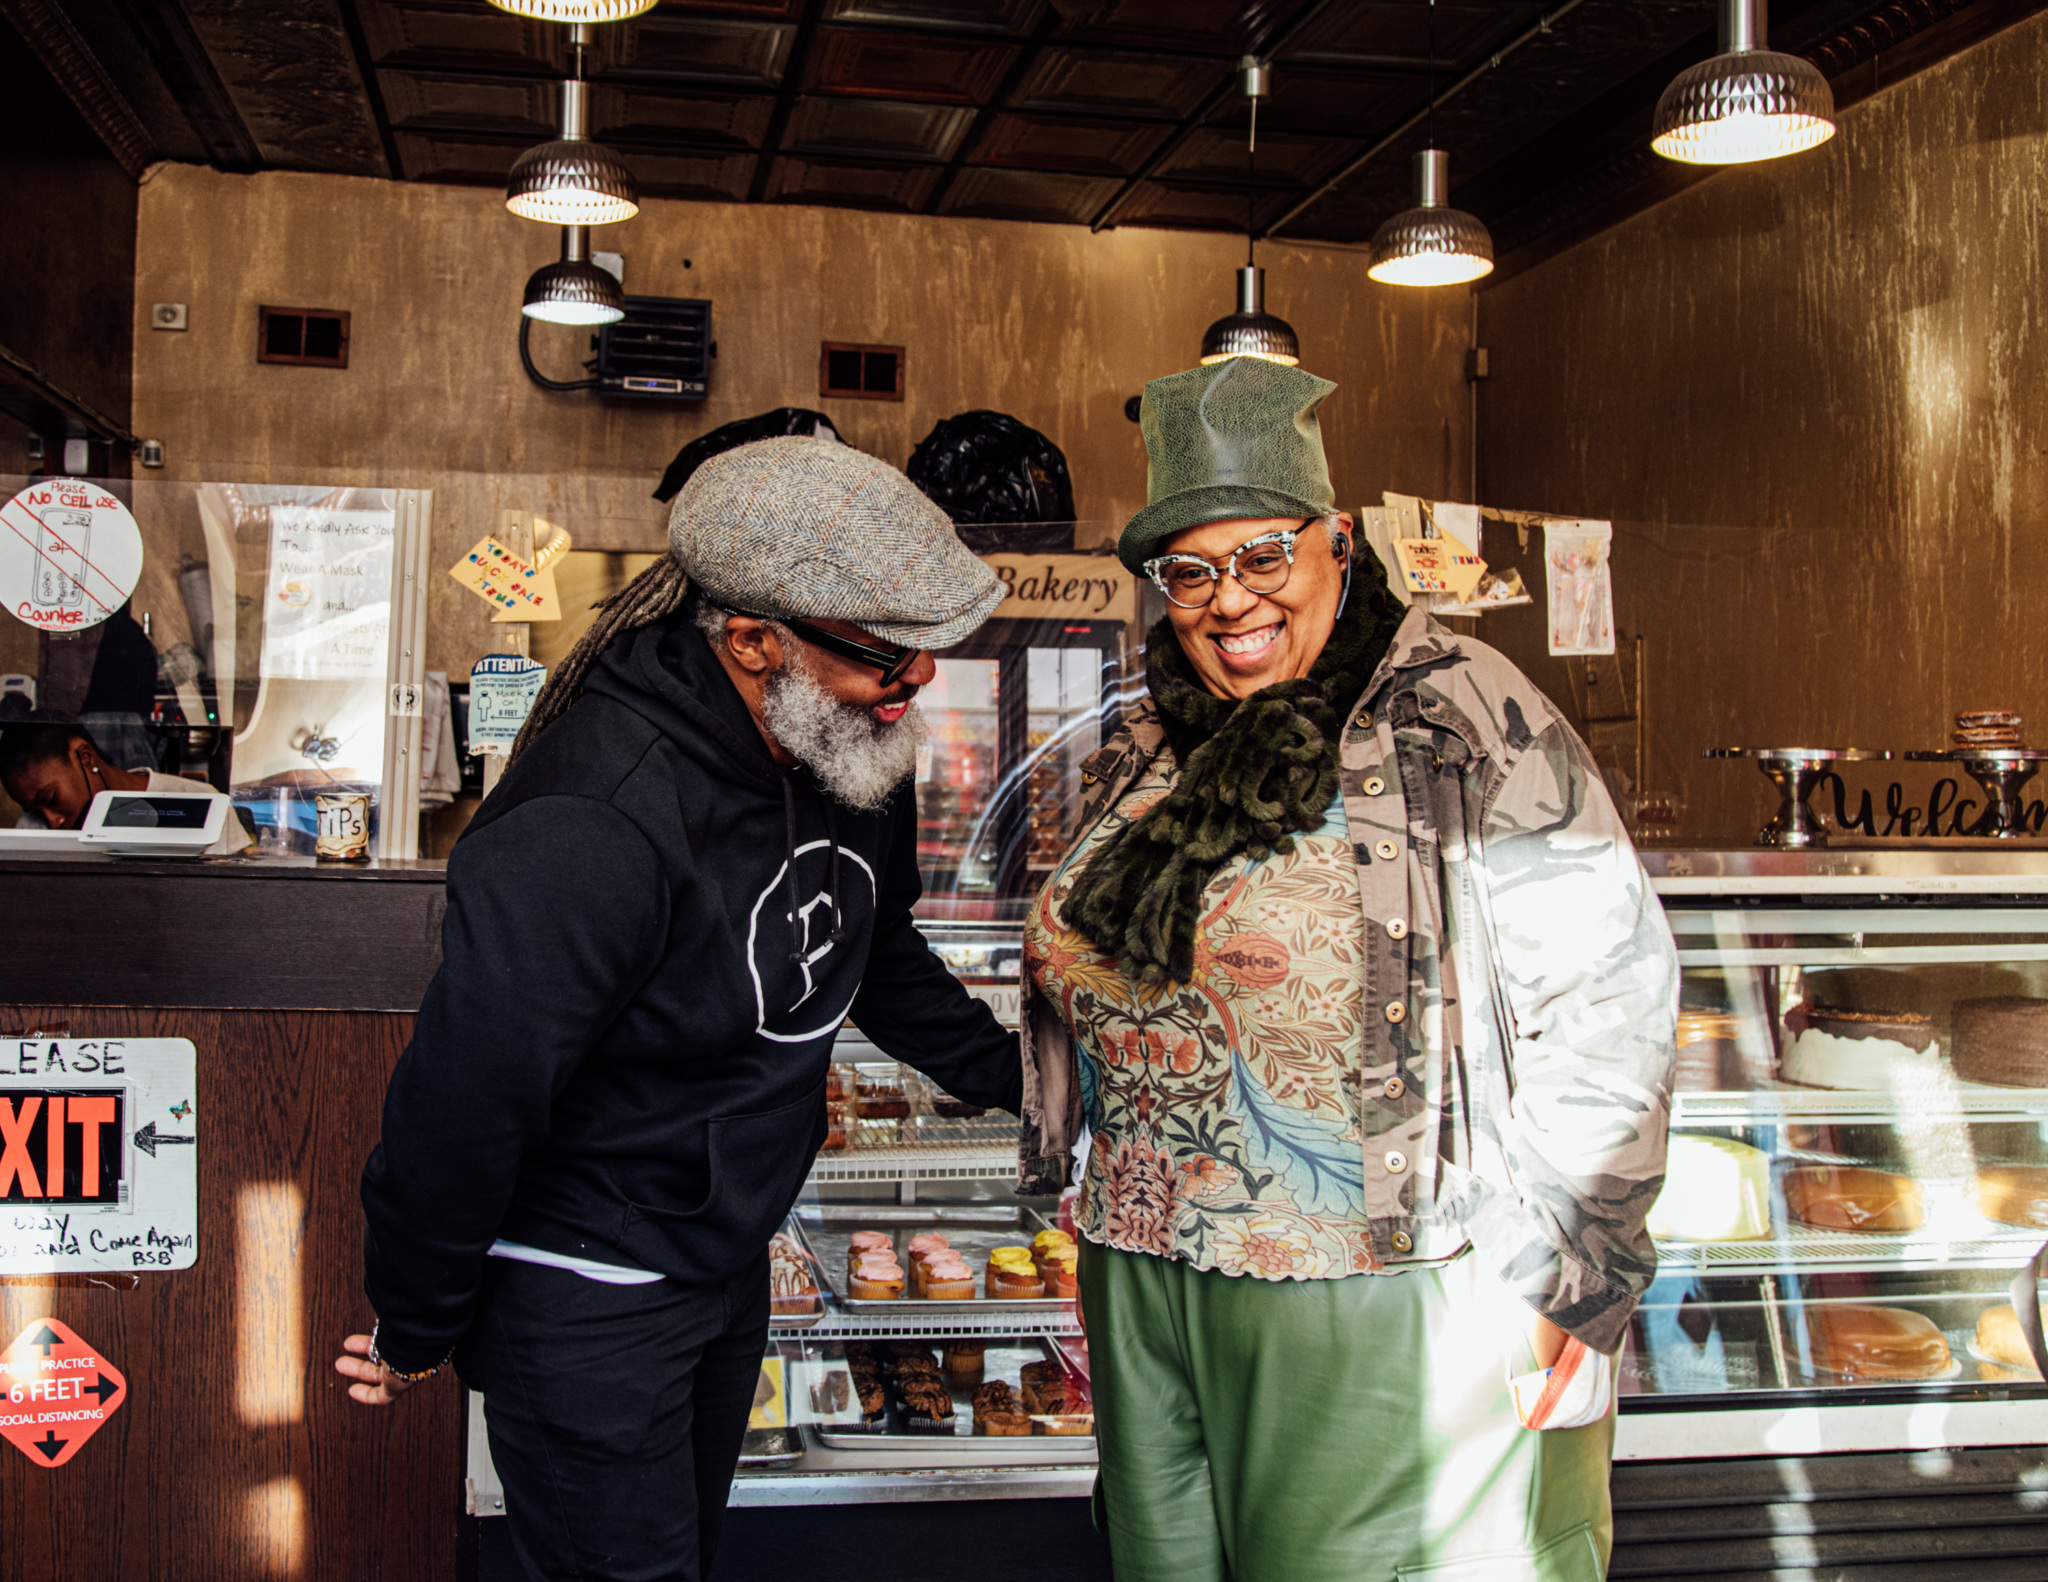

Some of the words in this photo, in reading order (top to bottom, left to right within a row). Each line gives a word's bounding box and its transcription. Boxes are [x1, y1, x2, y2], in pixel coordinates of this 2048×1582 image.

[51, 481, 86, 494] Please
[28, 491, 52, 505] NO
[60, 493, 93, 509] CELL
[345, 523, 369, 536] Ask
[280, 562, 313, 574] Wear
[330, 565, 364, 577] Mask
[510, 583, 544, 606] SALE
[996, 565, 1118, 613] Bakery
[343, 643, 374, 656] Time
[90, 1228, 143, 1253] Come
[147, 1226, 193, 1255] Again
[132, 1251, 173, 1266] BSB
[41, 1357, 96, 1372] PRACTICE
[9, 1383, 24, 1404] 6
[29, 1376, 85, 1402] FEET
[37, 1408, 104, 1424] DISTANCING
